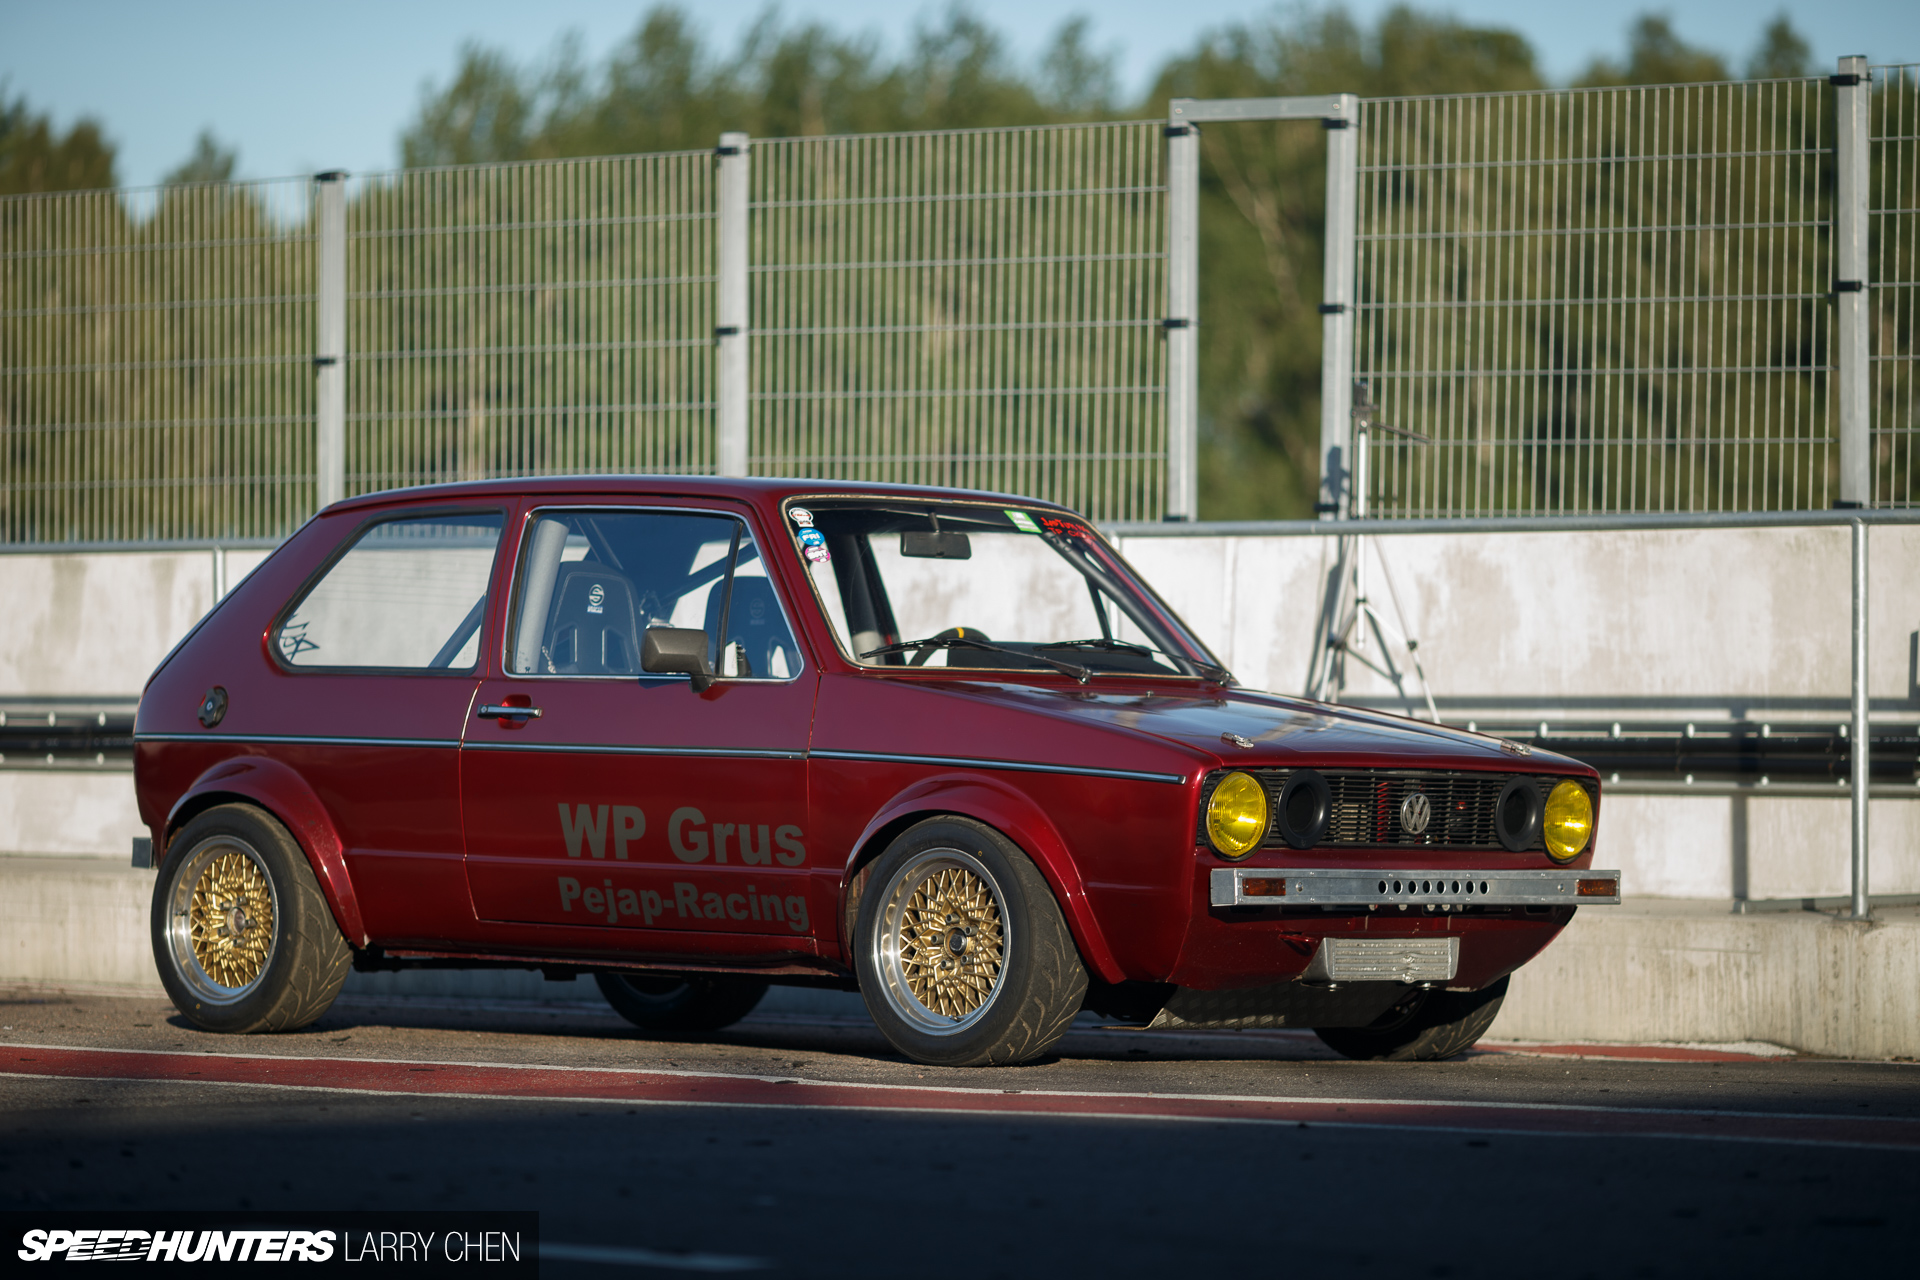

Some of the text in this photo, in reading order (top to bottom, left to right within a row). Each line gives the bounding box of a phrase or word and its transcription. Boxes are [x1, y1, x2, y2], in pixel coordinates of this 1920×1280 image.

[557, 803, 807, 867] WP Grus
[557, 876, 810, 932] Pejap-Racing
